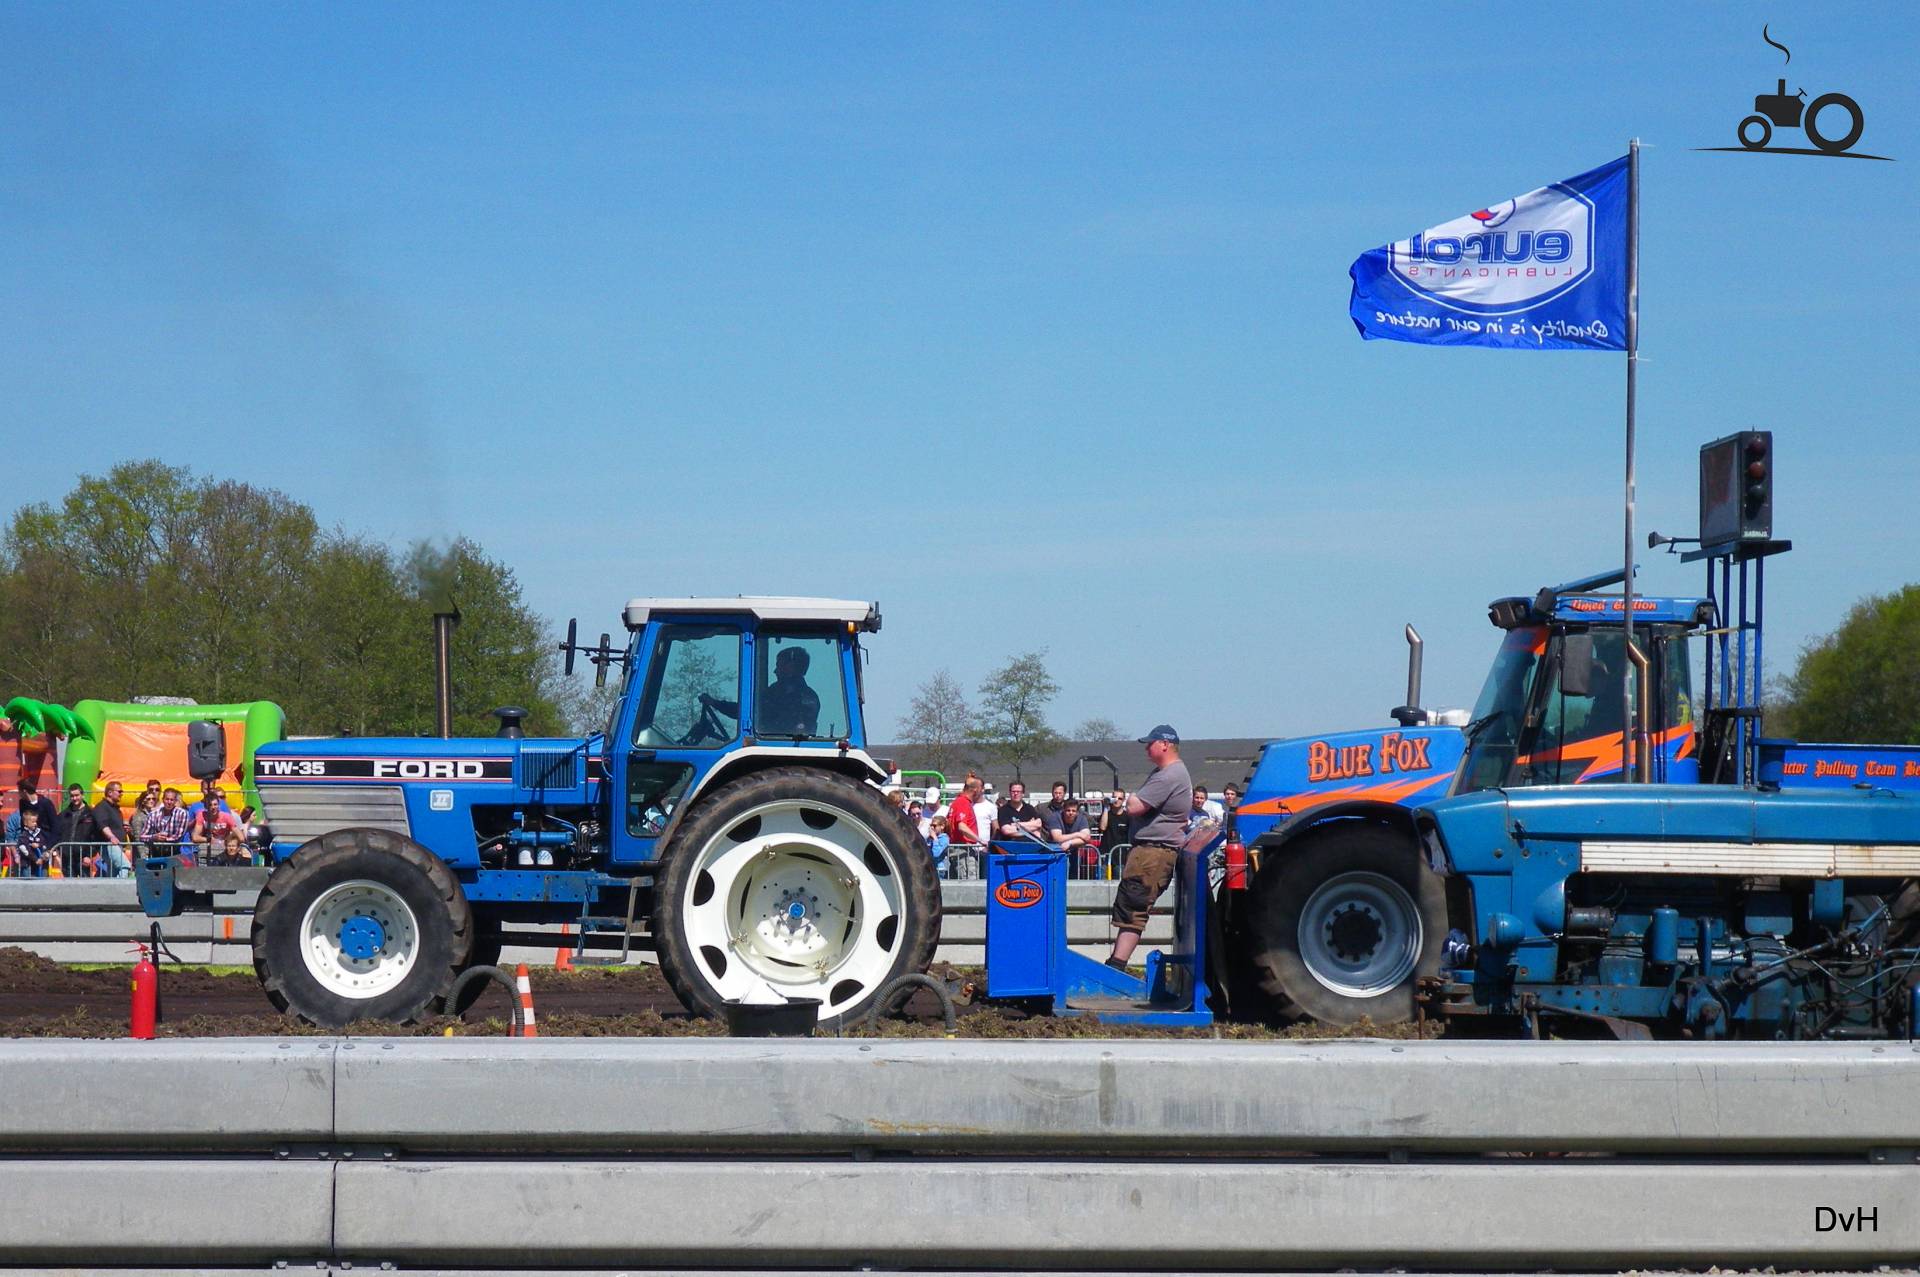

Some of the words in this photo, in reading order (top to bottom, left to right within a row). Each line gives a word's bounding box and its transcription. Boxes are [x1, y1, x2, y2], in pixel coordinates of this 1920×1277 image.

[259, 760, 326, 776] TW-35
[373, 760, 484, 779] FORD
[1814, 760, 1859, 778] Pulling
[1865, 761, 1897, 776] Team
